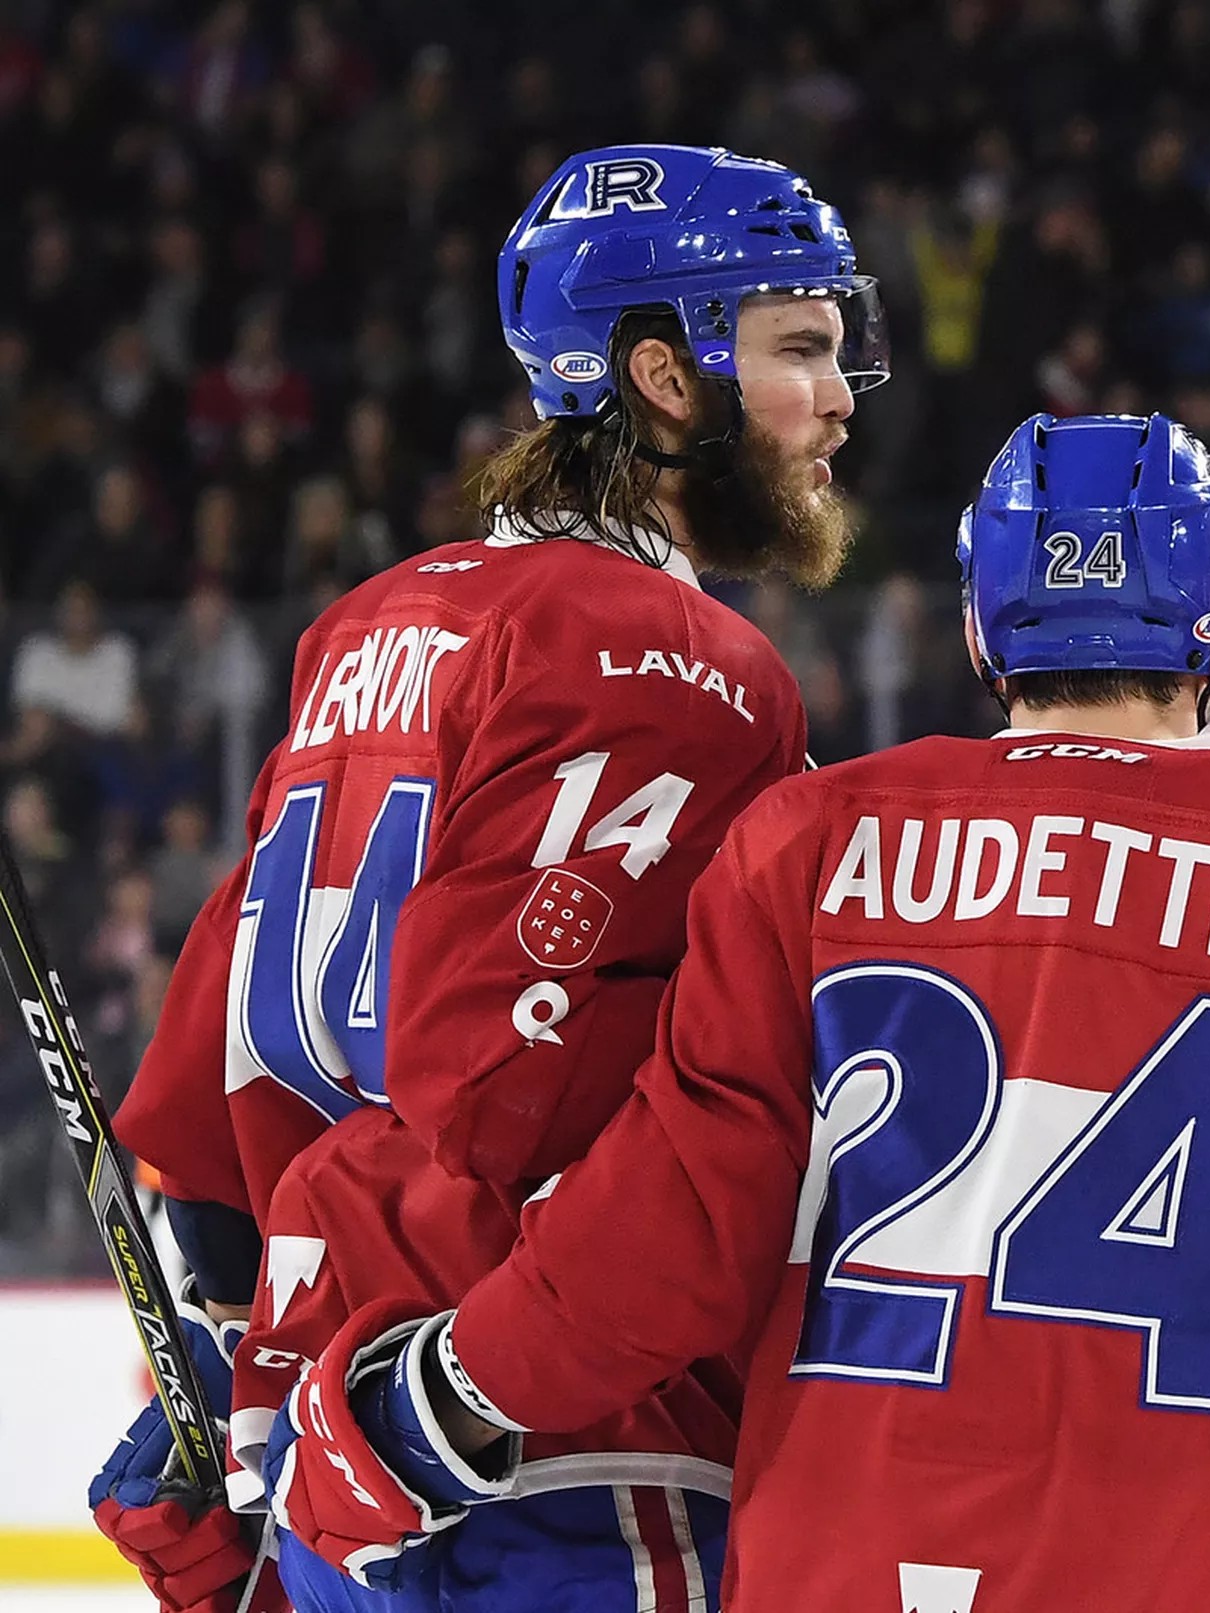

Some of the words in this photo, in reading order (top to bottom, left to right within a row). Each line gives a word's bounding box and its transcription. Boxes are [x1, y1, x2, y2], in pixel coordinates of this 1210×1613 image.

[585, 157, 668, 219] R
[1044, 531, 1126, 589] 24
[598, 649, 755, 723] LAVAL
[531, 751, 695, 880] 14
[1006, 743, 1149, 764] CCM
[240, 776, 437, 1125] 14
[20, 997, 93, 1143] CCM
[48, 968, 101, 1098] CCM
[112, 1224, 148, 1303] SUPER
[133, 1304, 197, 1426] TACKS
[188, 1425, 210, 1460] 2.0
